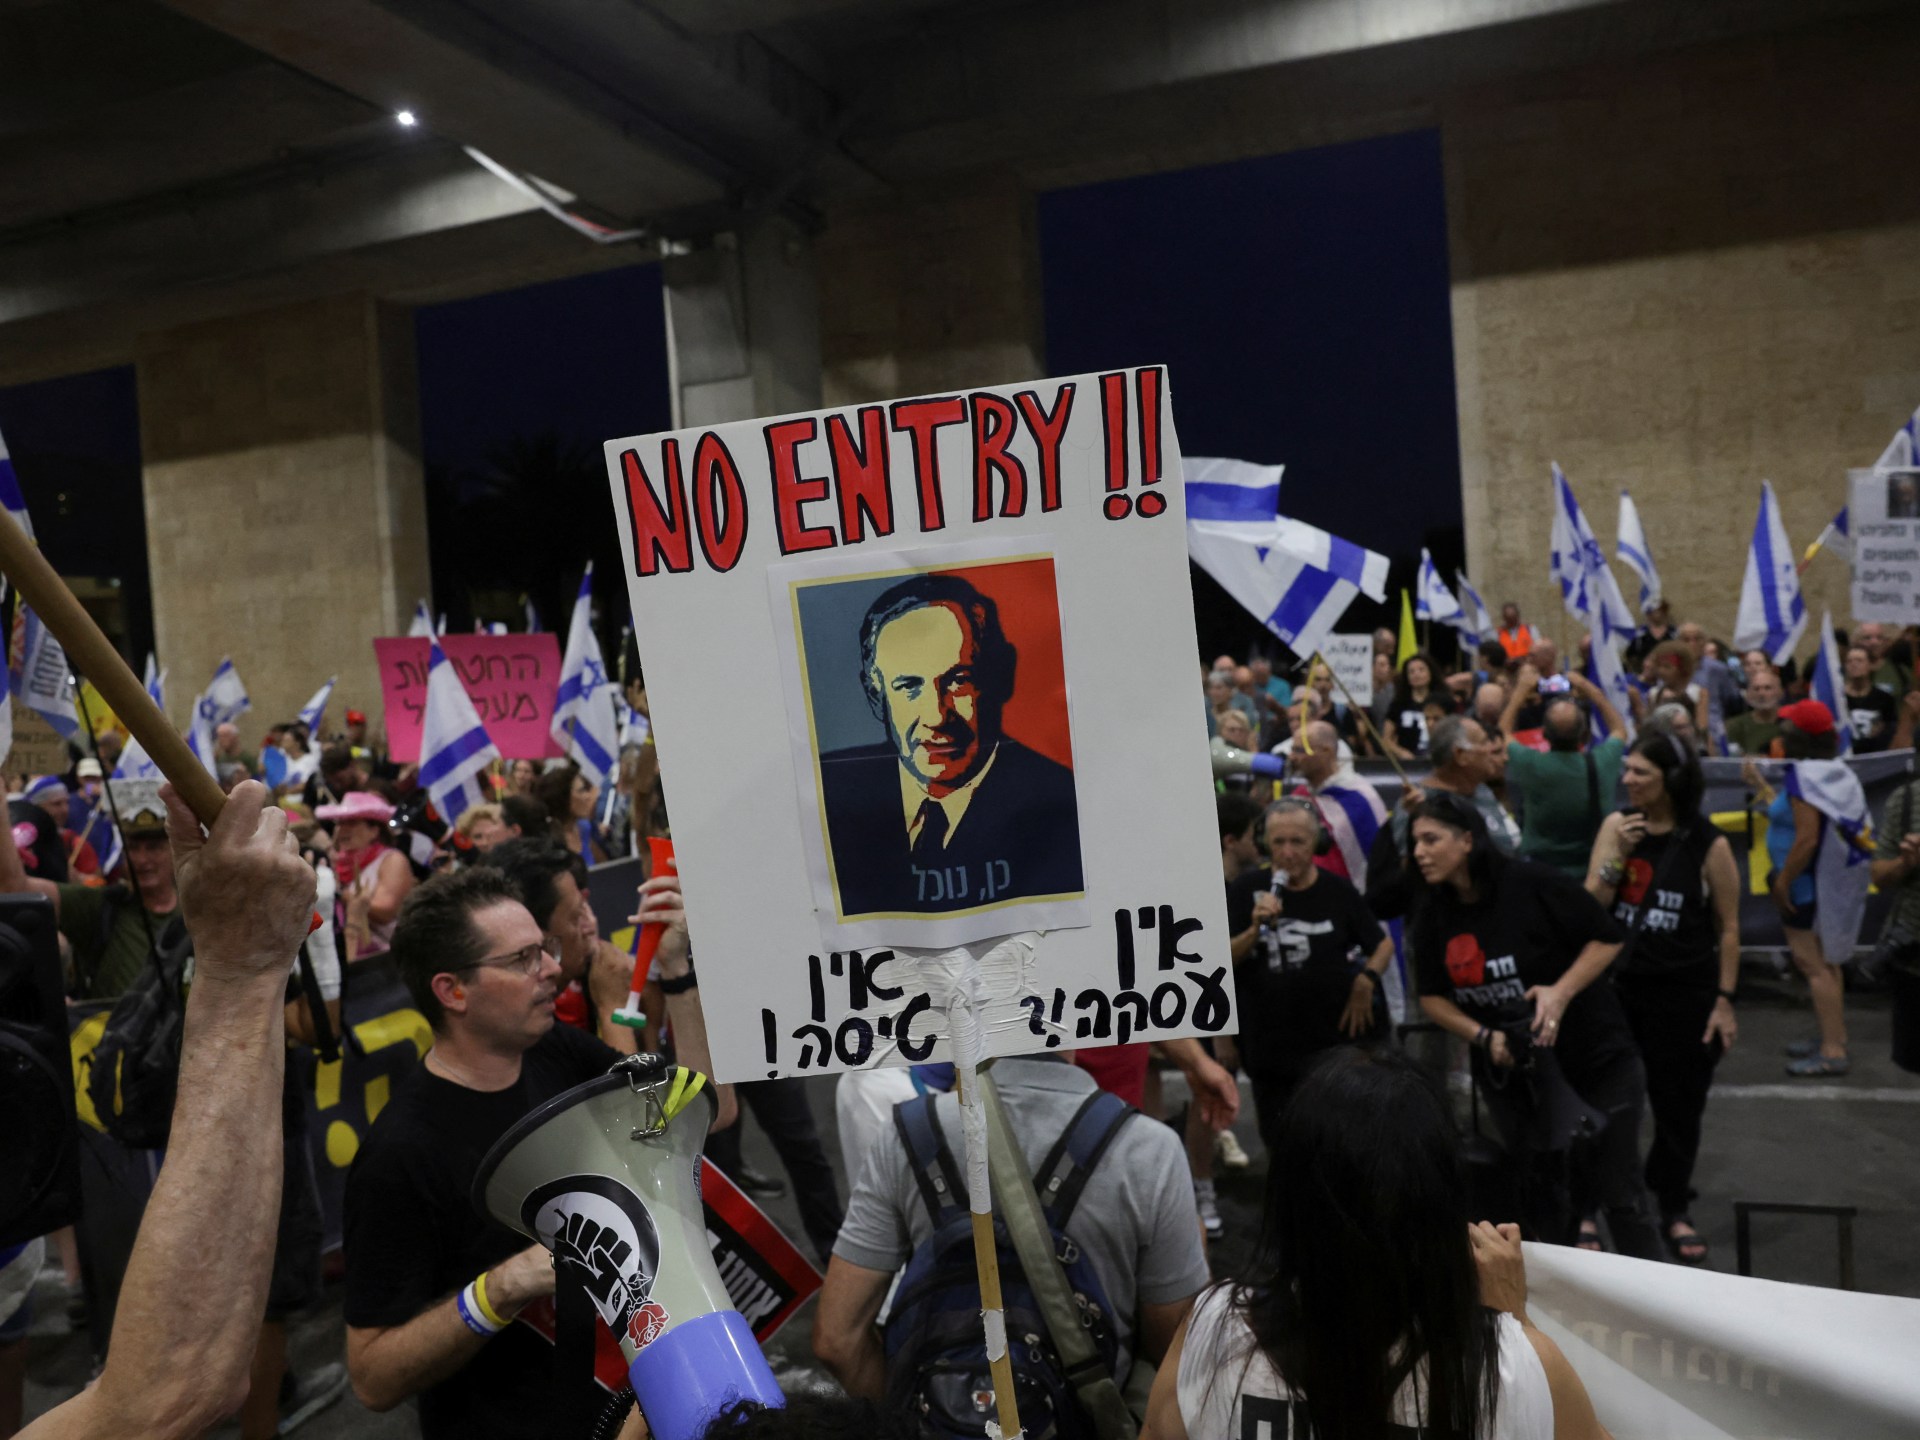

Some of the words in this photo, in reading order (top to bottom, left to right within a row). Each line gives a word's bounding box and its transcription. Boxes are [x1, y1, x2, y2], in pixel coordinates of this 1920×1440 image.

[620, 431, 749, 577] NO
[763, 383, 1077, 556] ENTRY
[911, 863, 969, 902] נוכל
[979, 858, 1012, 901] כן,
[1115, 904, 1204, 991] אין
[808, 950, 905, 1023] אין
